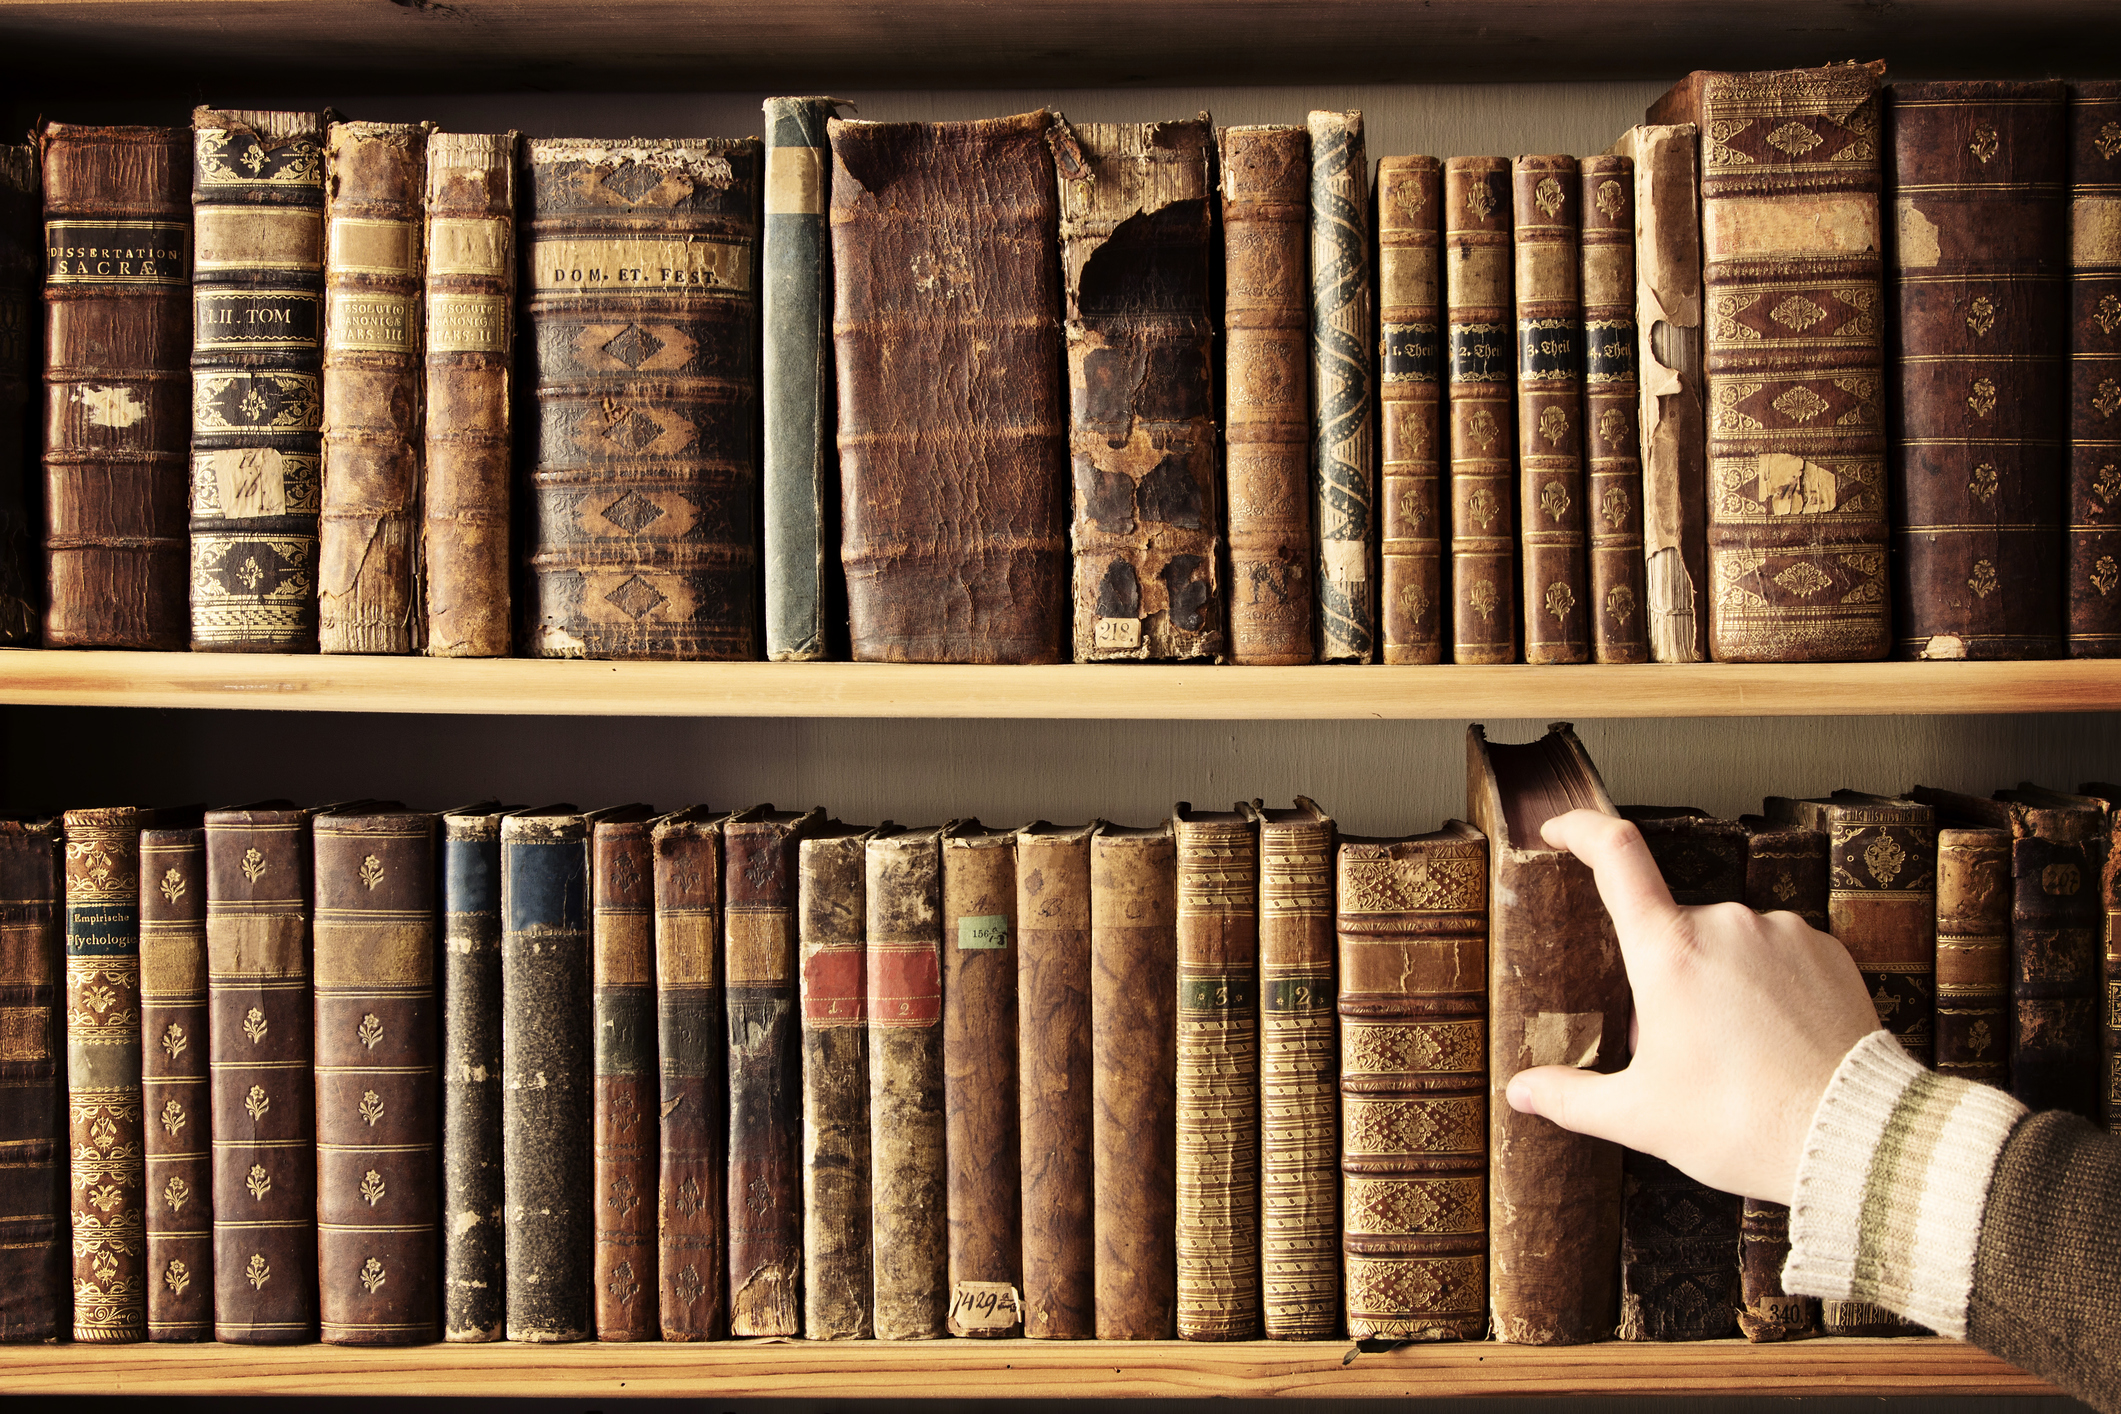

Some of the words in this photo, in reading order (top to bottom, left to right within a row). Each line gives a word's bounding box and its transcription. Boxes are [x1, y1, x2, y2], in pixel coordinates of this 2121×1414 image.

[555, 268, 609, 282] DOM.
[619, 268, 650, 282] ET.
[662, 268, 720, 285] FEST.
[246, 308, 291, 324] TOM
[1458, 346, 1472, 357] 2.
[1527, 343, 1539, 358] 3.
[1541, 340, 1571, 358] Theil
[1604, 341, 1632, 359] Theil
[74, 913, 130, 925] Empirische
[1215, 987, 1228, 1005] 3
[1295, 987, 1311, 1005] 2
[1770, 1304, 1804, 1324] 340.
